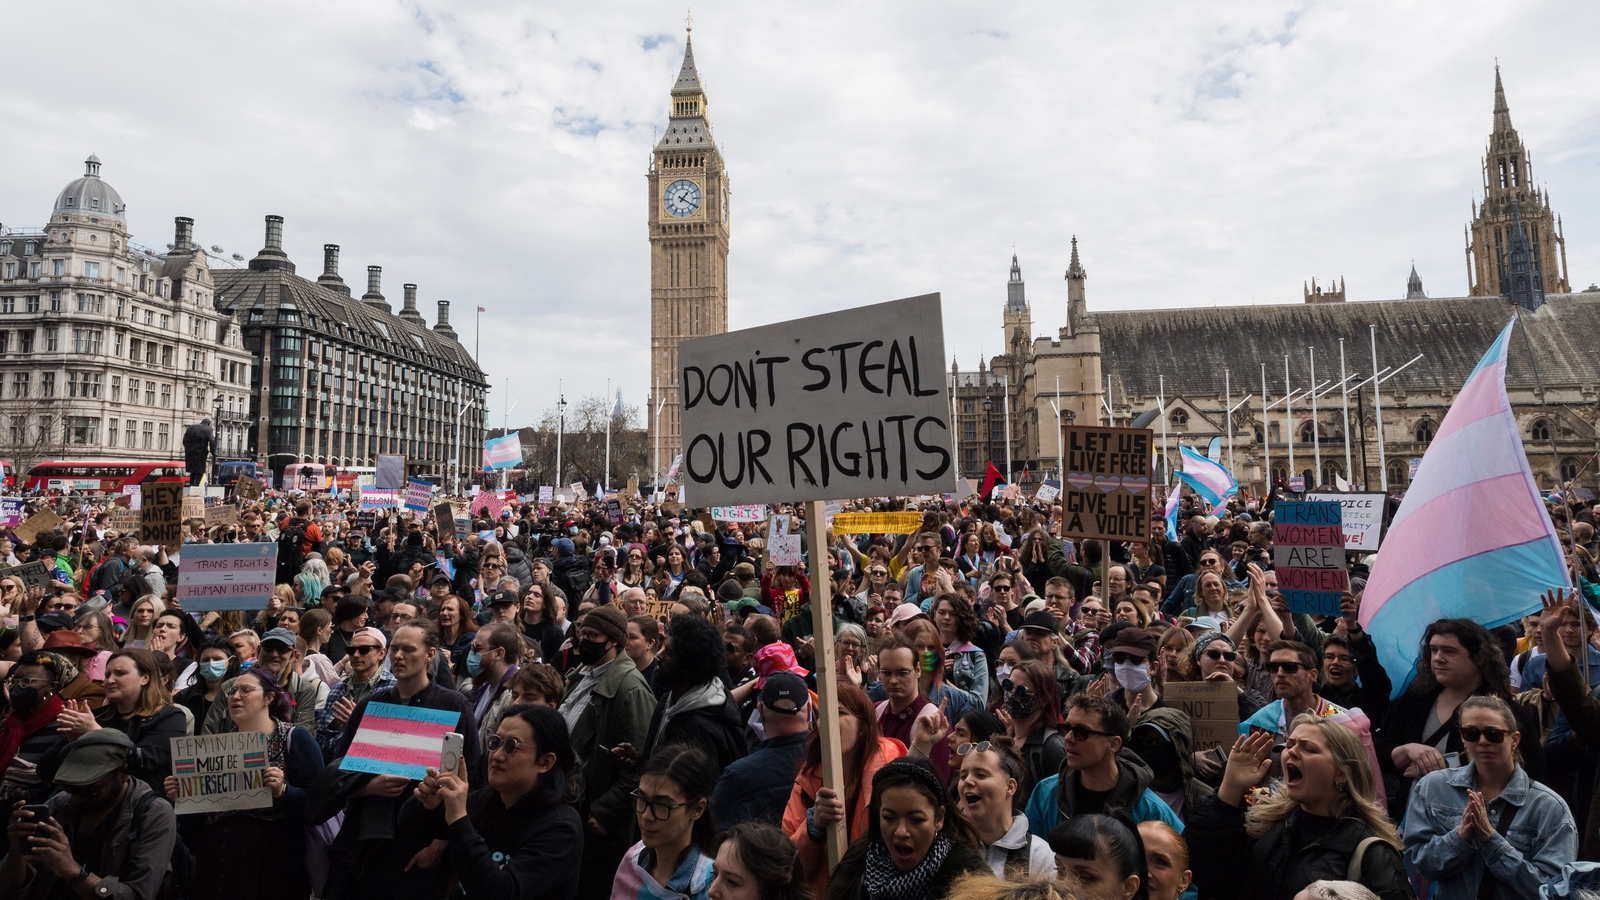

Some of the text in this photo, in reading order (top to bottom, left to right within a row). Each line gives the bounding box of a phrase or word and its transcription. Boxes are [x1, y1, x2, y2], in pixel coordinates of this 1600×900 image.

[801, 336, 939, 397] STEAL
[1070, 431, 1147, 454] LET US
[686, 415, 950, 489] OUR RIGHTS
[1069, 451, 1146, 475] LIVE FREE
[406, 491, 431, 499] LIBERATION
[410, 482, 430, 491] TRANS
[143, 486, 182, 508] HEY,
[408, 497, 426, 506] NOW
[1067, 491, 1107, 514] GIVE
[1117, 495, 1146, 517] US
[1331, 499, 1373, 509] OICE
[2, 508, 20, 517] ights
[142, 506, 179, 522] MAYBE
[713, 508, 759, 520] RIGHTS
[1277, 503, 1341, 525] TRANS
[1067, 512, 1145, 537] A VOICE
[1275, 525, 1340, 545] WOMEN
[1344, 532, 1365, 546] VE!
[194, 559, 269, 569] TRANS RIGHTS
[1288, 547, 1334, 567] ARE
[21, 565, 46, 577] NEED
[1277, 571, 1344, 590] WOMEN
[188, 584, 270, 597] HUMAN RIGHTS
[1183, 701, 1215, 718] NOT
[404, 708, 443, 731] Rights
[1201, 727, 1213, 736] MY
[176, 732, 260, 757] FEMINISM
[196, 755, 238, 773] MUST BE
